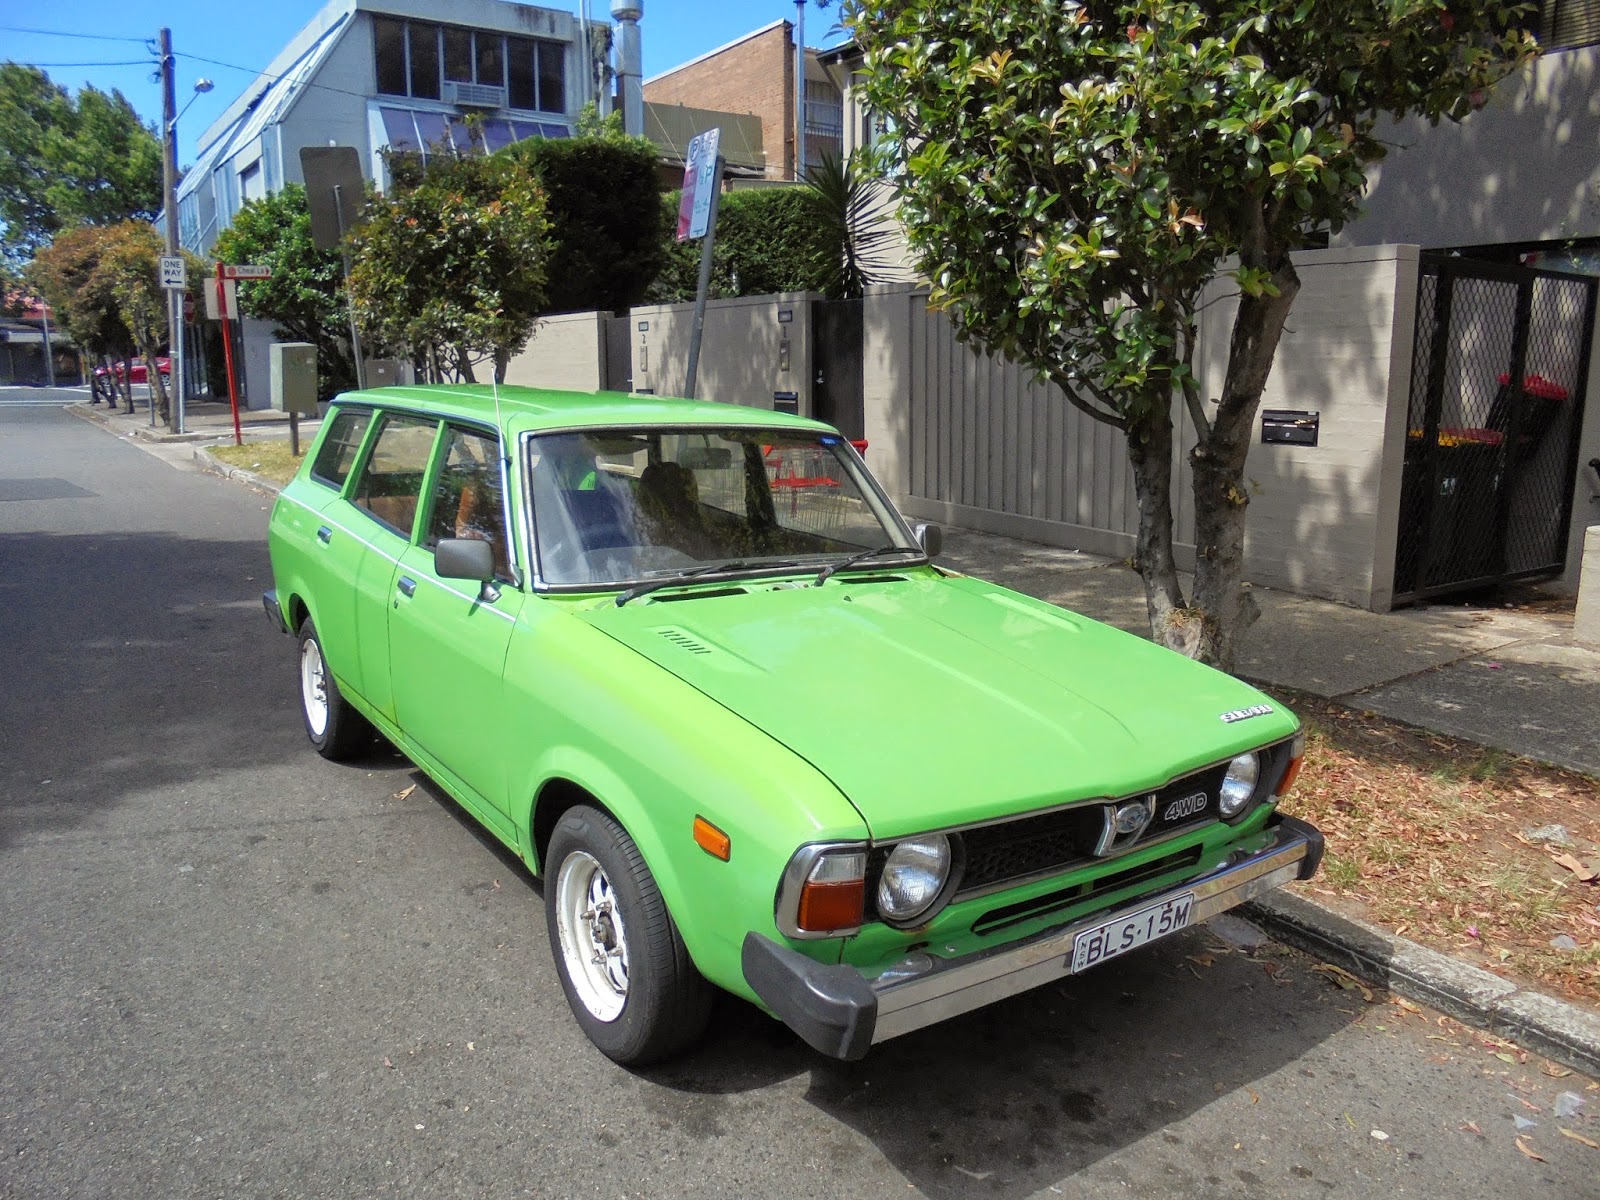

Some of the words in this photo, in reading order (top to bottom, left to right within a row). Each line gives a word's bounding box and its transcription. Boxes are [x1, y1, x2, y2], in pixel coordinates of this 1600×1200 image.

[164, 261, 181, 269] ONE
[1220, 704, 1273, 723] SUBARU
[1164, 792, 1208, 821] 4WD
